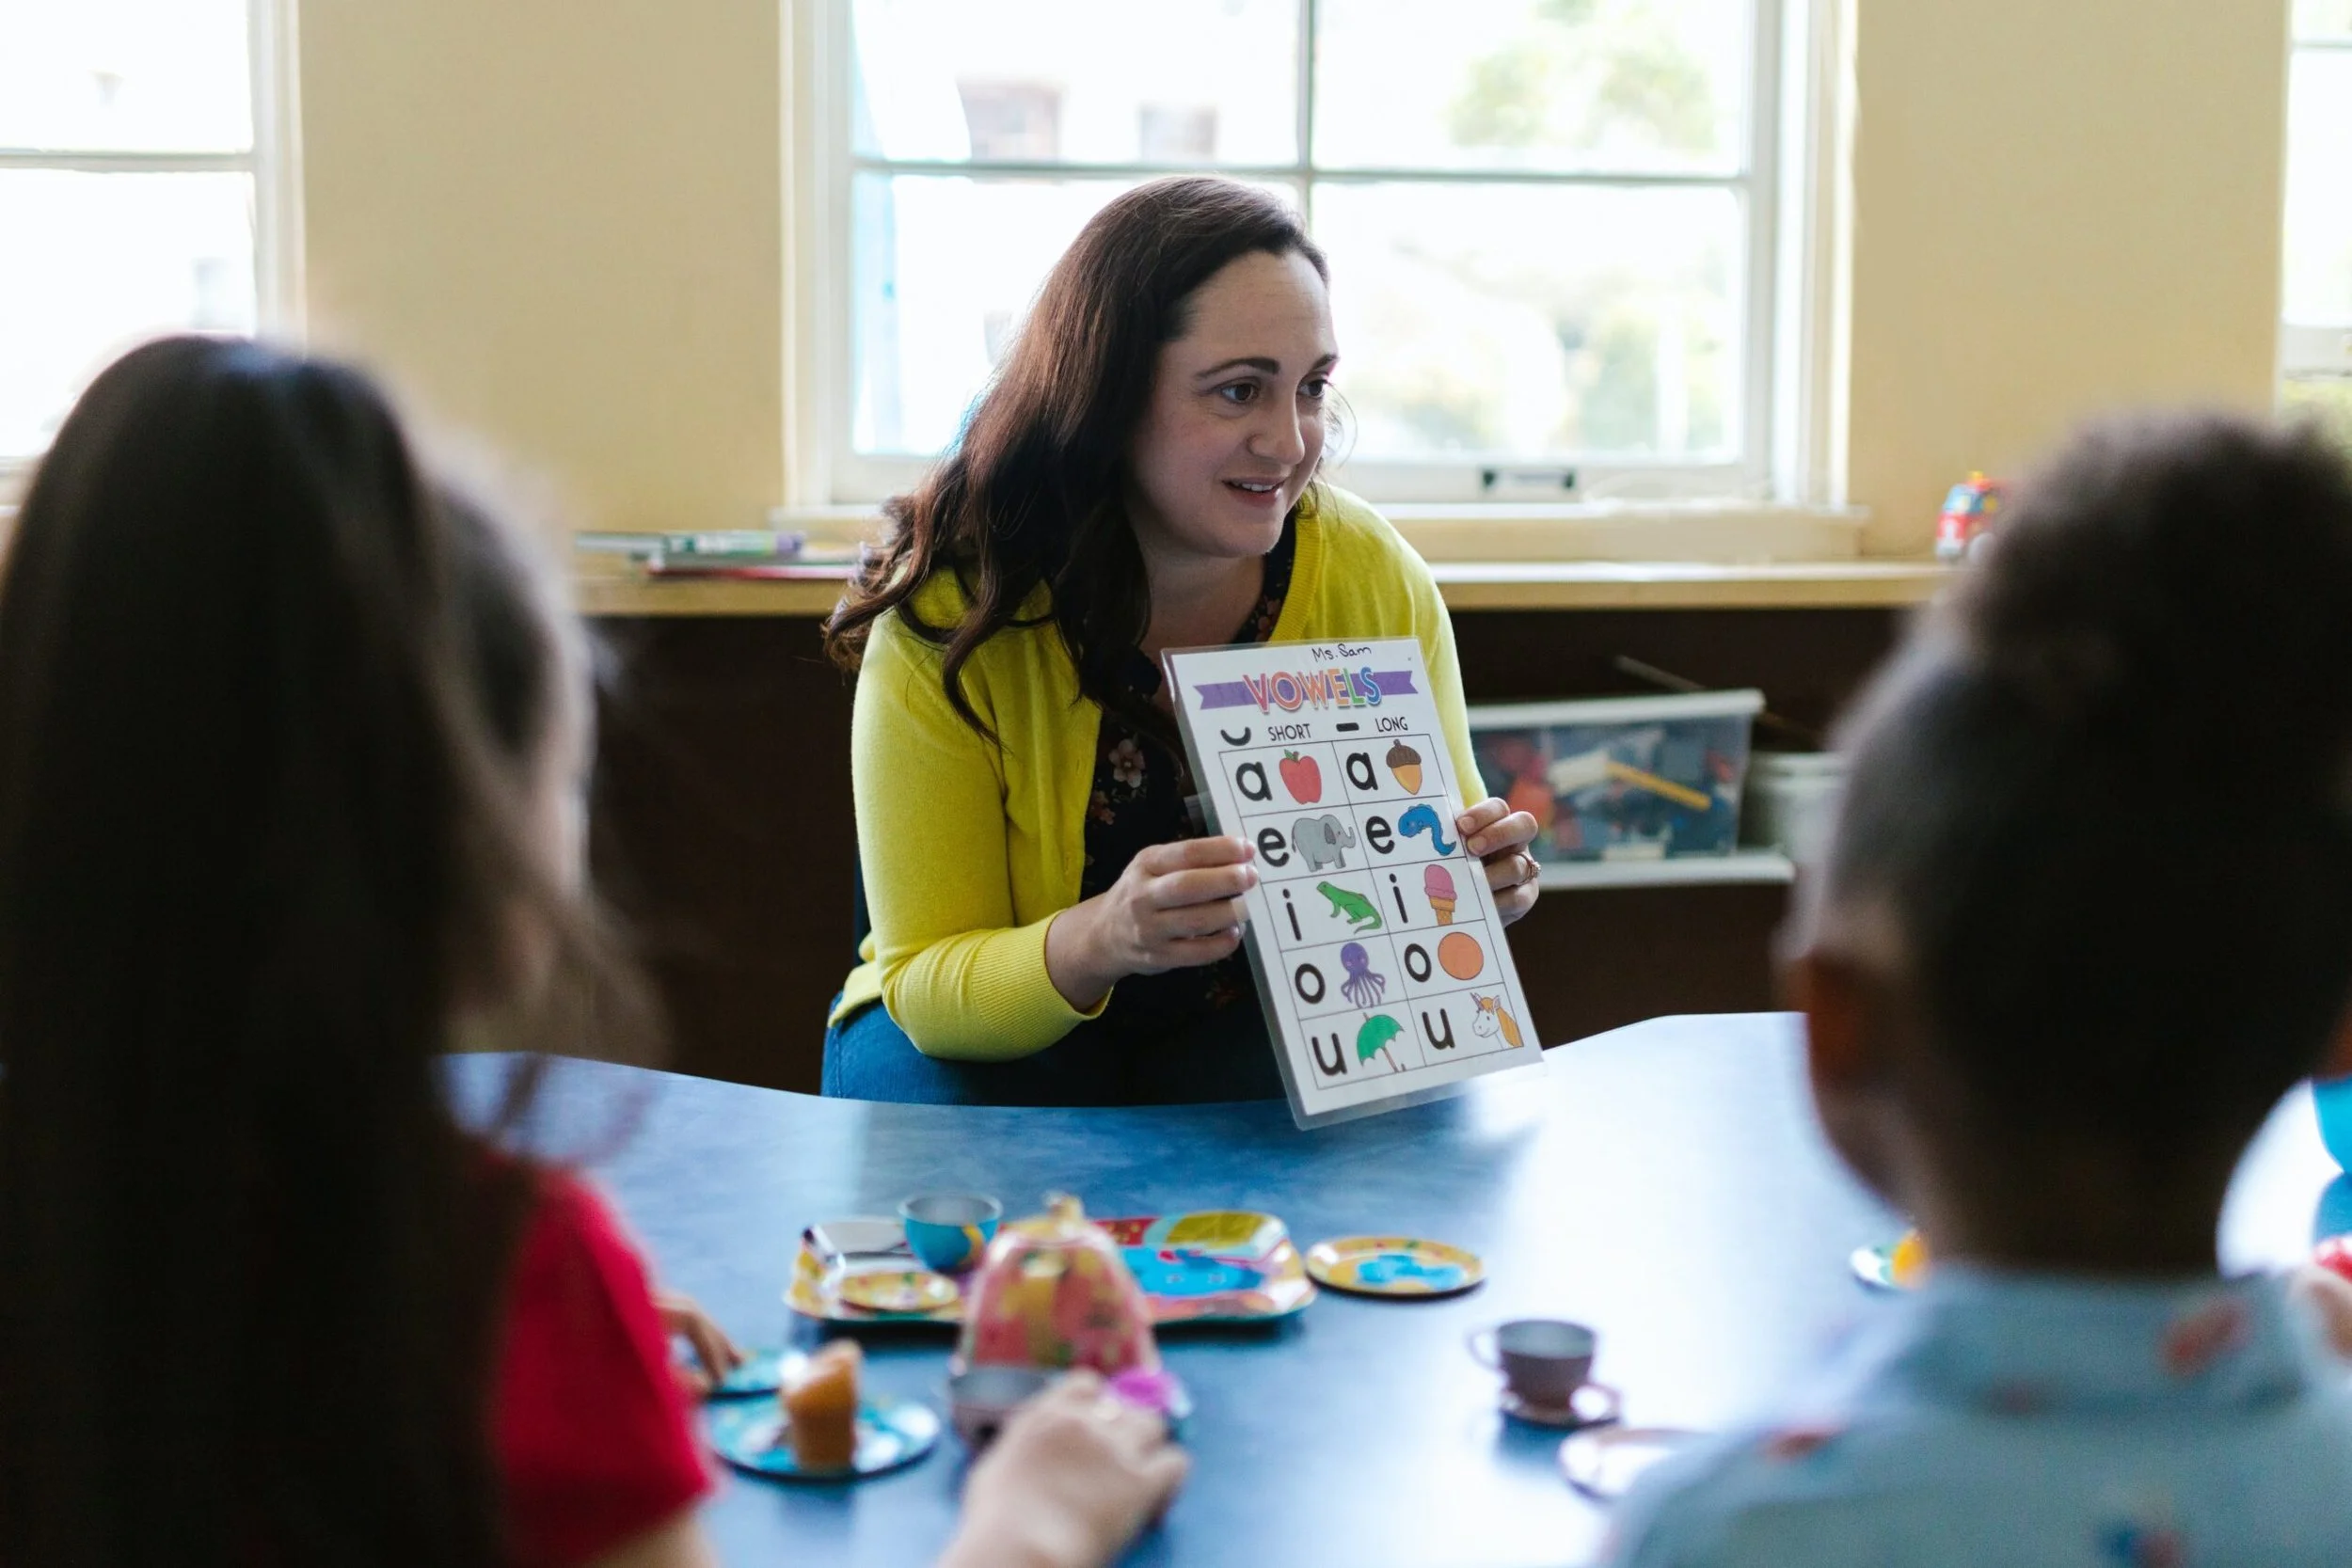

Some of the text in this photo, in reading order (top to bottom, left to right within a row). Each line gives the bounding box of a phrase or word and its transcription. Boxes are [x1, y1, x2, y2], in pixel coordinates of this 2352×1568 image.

[1311, 643, 1372, 662] Ms. Sam
[1242, 666, 1382, 715] VOWELS
[1268, 722, 1313, 742] SHORT
[1375, 716, 1408, 733] LONG
[1235, 761, 1273, 801] a
[1345, 752, 1378, 791] a
[1257, 827, 1290, 867] e
[1365, 816, 1395, 855] e
[1282, 889, 1302, 941] i
[1389, 873, 1408, 924] i
[1404, 942, 1432, 983] o
[1295, 963, 1326, 1005] o
[1422, 1008, 1455, 1050] u
[1311, 1032, 1347, 1076] u
